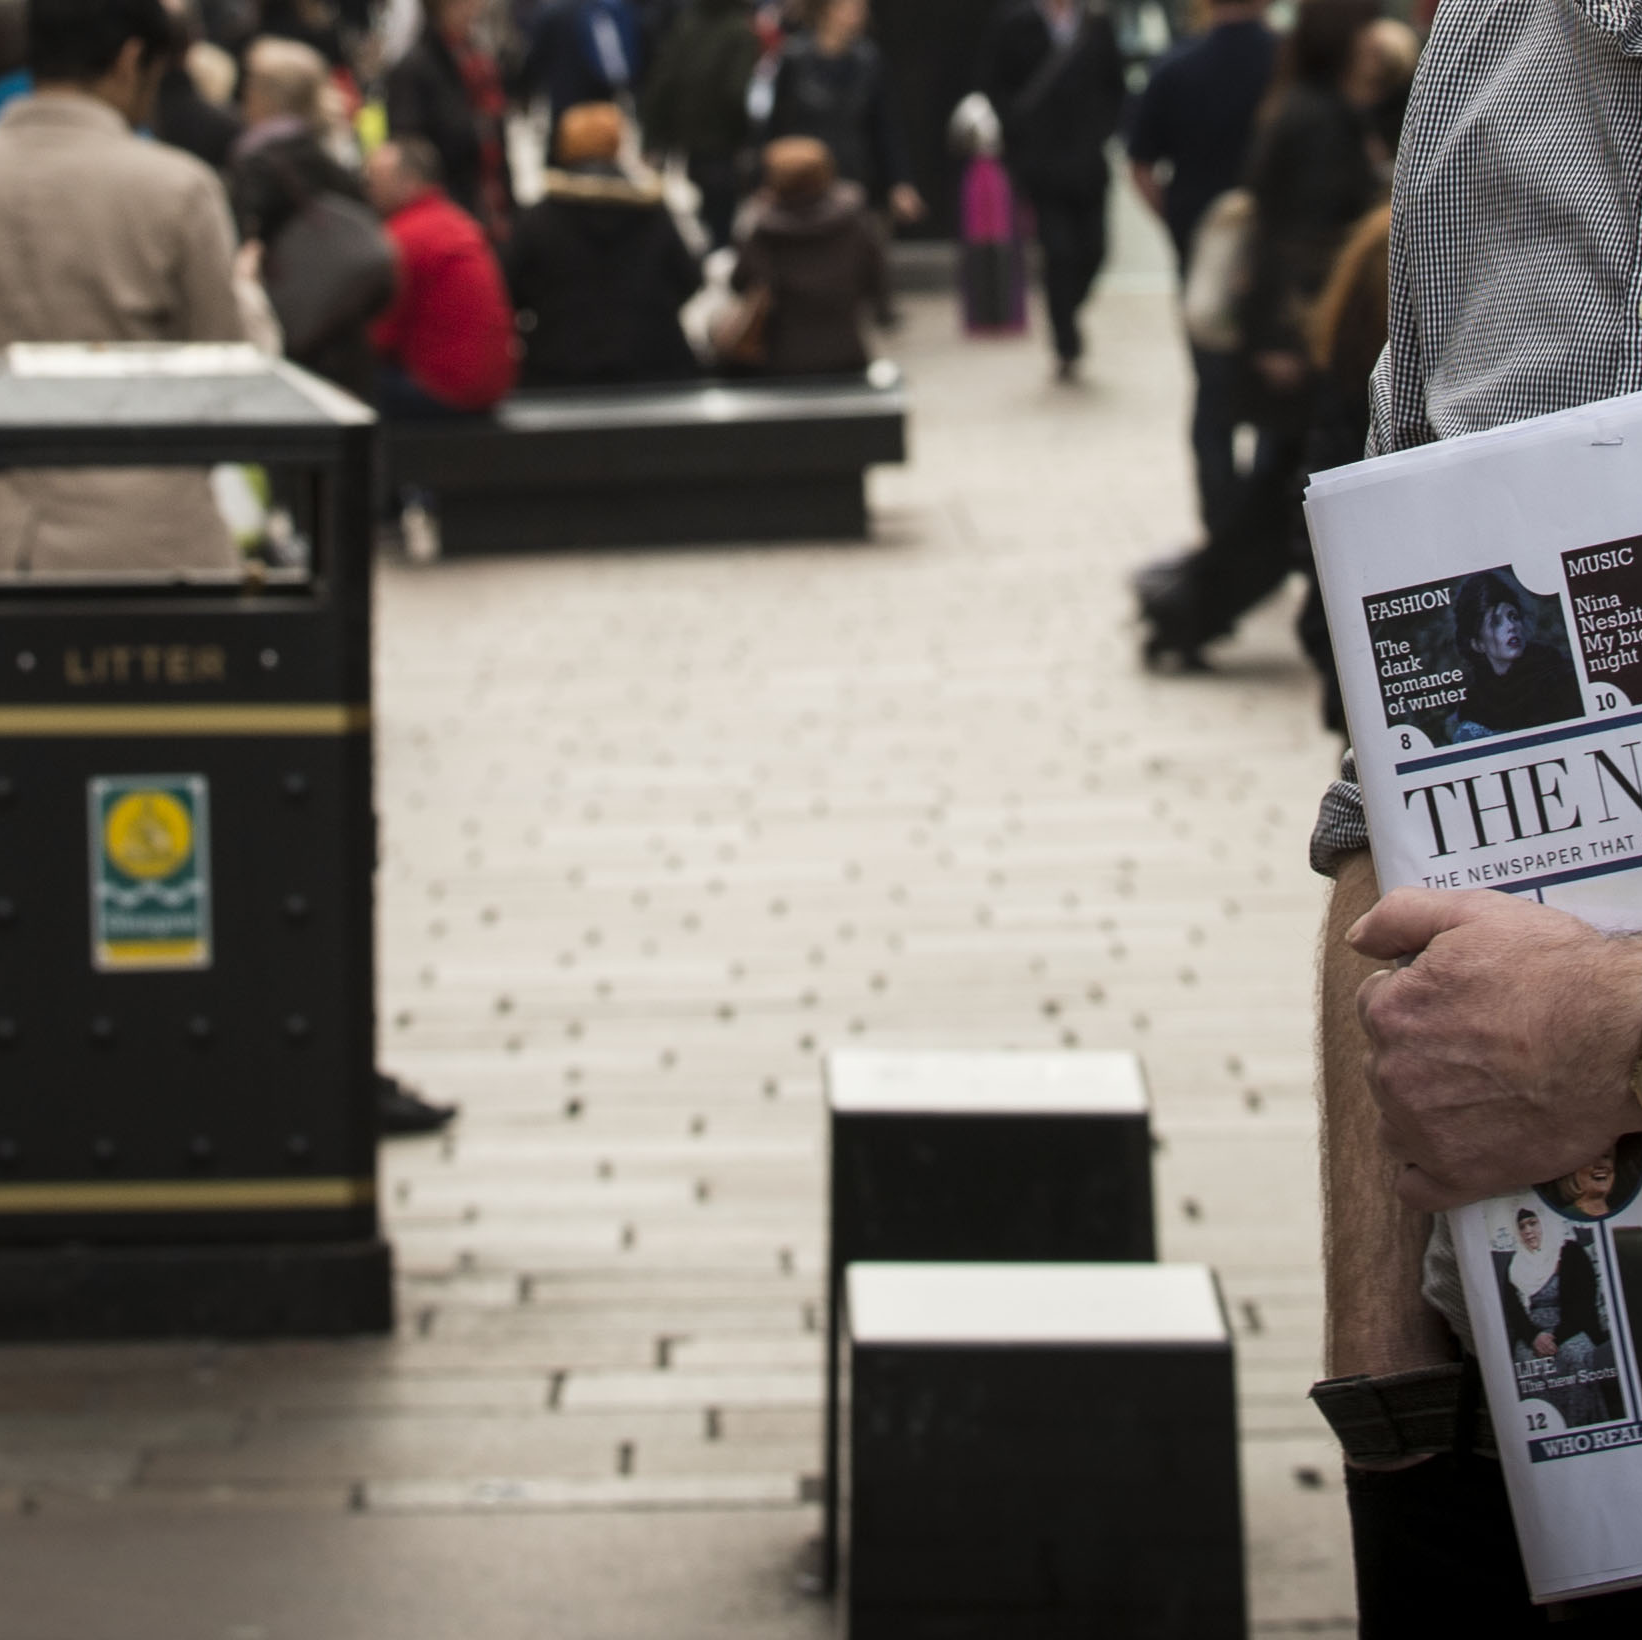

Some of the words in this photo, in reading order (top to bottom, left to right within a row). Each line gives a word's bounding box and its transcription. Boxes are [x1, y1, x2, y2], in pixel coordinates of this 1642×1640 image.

[1567, 547, 1634, 577] MUSIC
[1367, 587, 1451, 622] FASHION
[1575, 593, 1622, 615] Nina
[1375, 639, 1410, 659] The
[1583, 635, 1614, 657] My
[64, 646, 226, 685] LITTER
[1380, 655, 1423, 678] dark
[1588, 647, 1640, 674] night
[1383, 668, 1464, 697] romance
[1387, 697, 1406, 716] of
[1407, 686, 1467, 712] winter
[1595, 692, 1617, 711] 10
[1400, 733, 1412, 750] 8
[1403, 758, 1582, 859] THE
[1422, 871, 1462, 889] THE
[1467, 846, 1584, 884] NEWSPAPER
[1589, 834, 1635, 859] THAT
[1514, 1356, 1557, 1379] LIFE
[1519, 1378, 1546, 1394] The
[1547, 1372, 1577, 1389] new
[1578, 1365, 1618, 1384] Scots
[1525, 1412, 1548, 1432] 12
[1541, 1434, 1590, 1458] WHO
